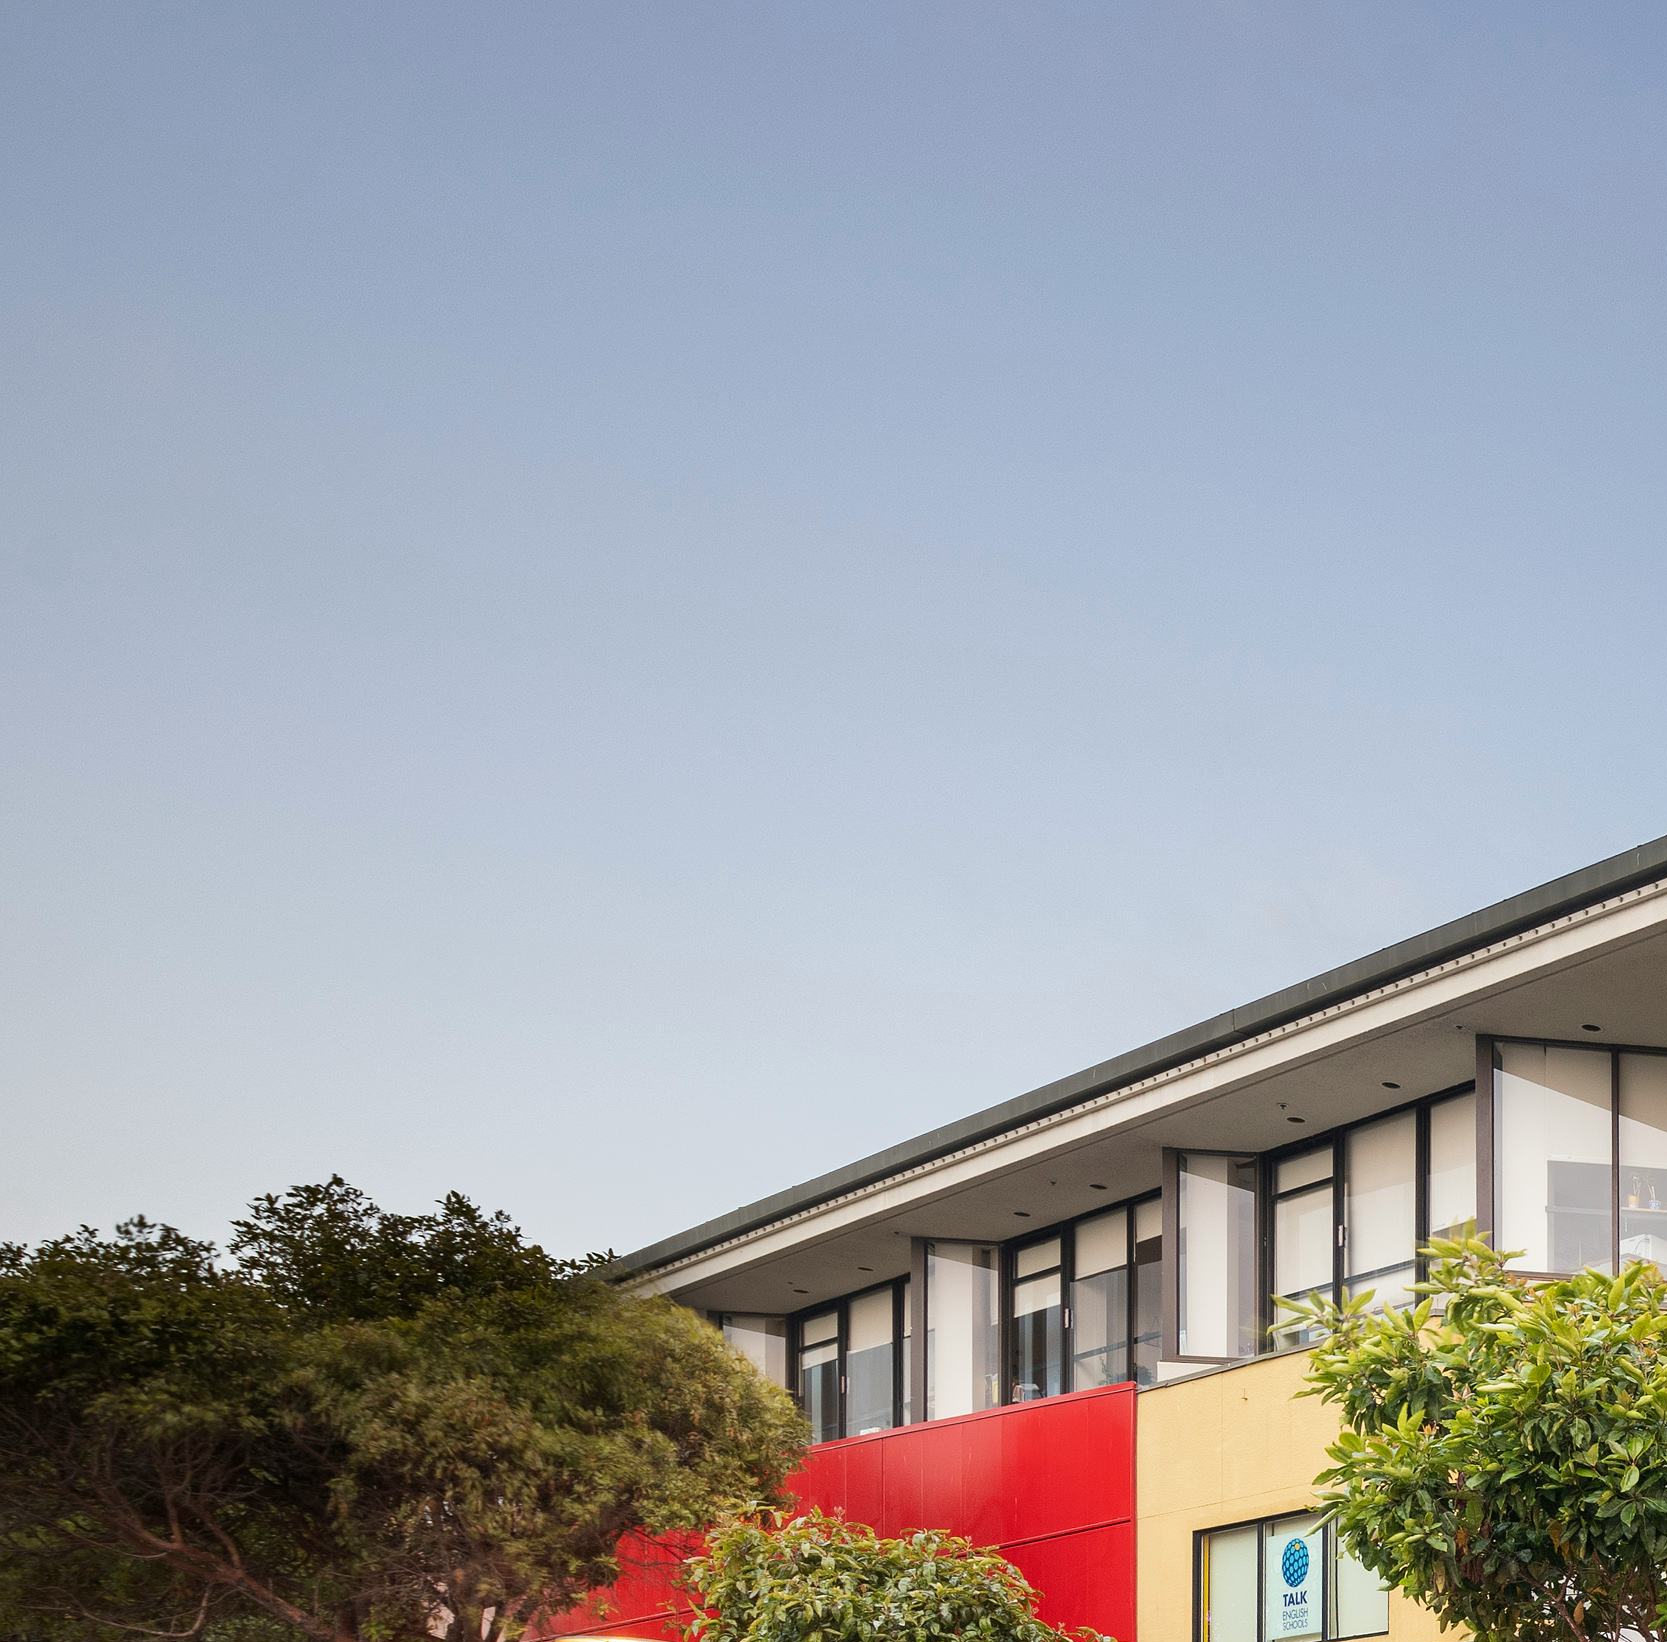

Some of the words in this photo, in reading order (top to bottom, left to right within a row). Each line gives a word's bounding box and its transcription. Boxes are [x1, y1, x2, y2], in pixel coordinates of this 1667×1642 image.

[1283, 1591, 1307, 1607] TALK
[1283, 1608, 1308, 1622] ENGLISH
[1283, 1619, 1307, 1631] SCHOOLS
